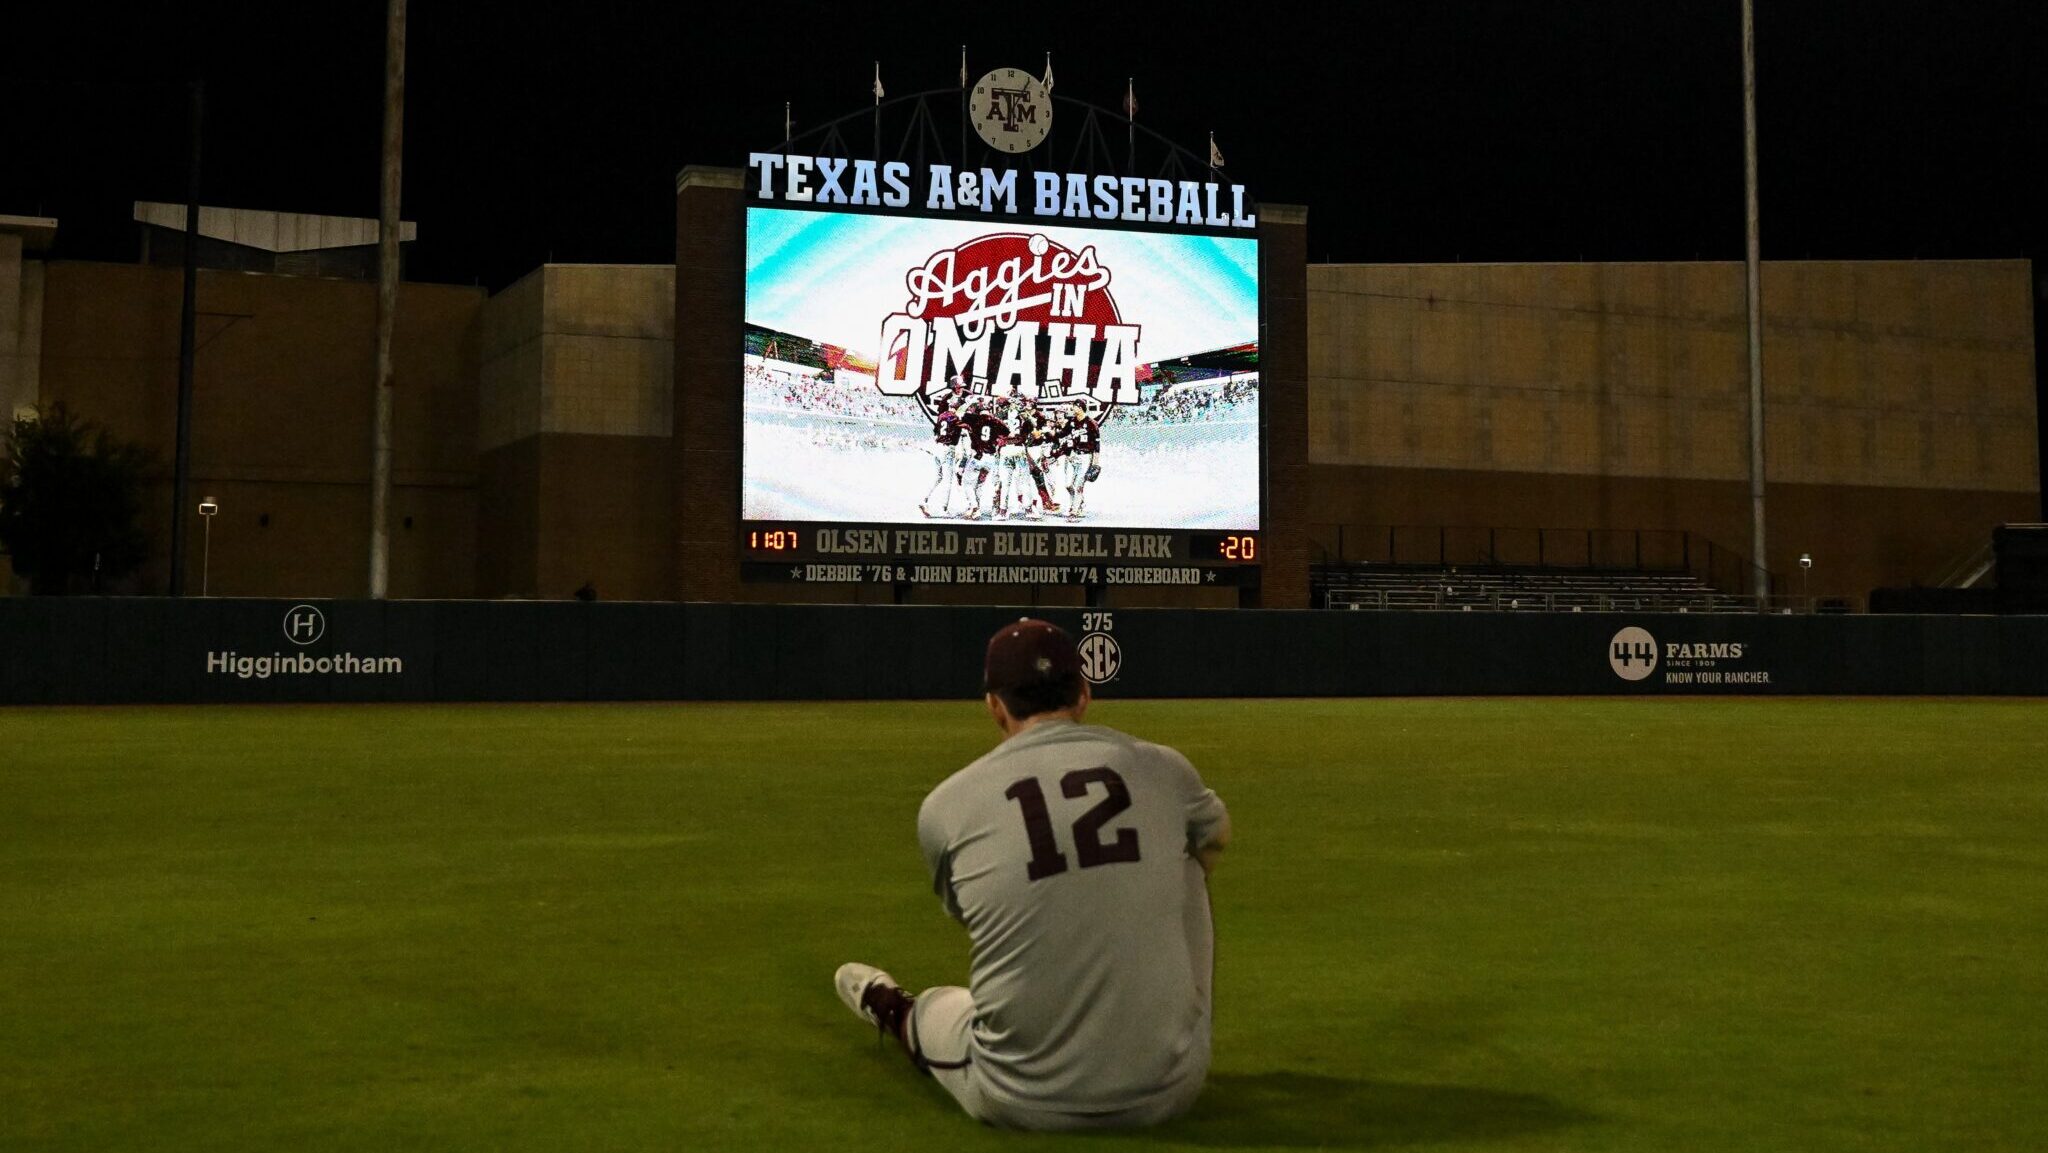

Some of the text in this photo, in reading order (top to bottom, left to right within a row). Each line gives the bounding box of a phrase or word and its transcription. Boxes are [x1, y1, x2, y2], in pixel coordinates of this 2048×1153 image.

[1007, 70, 1015, 78] 12
[1045, 110, 1050, 118] 3
[749, 152, 1256, 229] TEXAS A&M BASEBALL
[906, 244, 1112, 341] Aggies
[1051, 282, 1090, 318] IN
[876, 312, 1142, 405] OMAHA
[980, 425, 991, 442] 9
[751, 531, 798, 550] 11:07
[816, 529, 1172, 559] OLSEN FIELD AT BLUE BELL PARK
[805, 564, 1201, 585] DEBBIE '76 & JOHN BETHANCOURT '74 SCOREBOARD
[1082, 612, 1113, 631] 375
[1079, 635, 1117, 680] SEC
[1613, 642, 1654, 667] 44
[1666, 643, 1742, 658] FARMS
[207, 651, 403, 679] Higginbotham
[1666, 671, 1769, 684] KNOW YOUR RANCHER
[1005, 766, 1141, 881] 12
